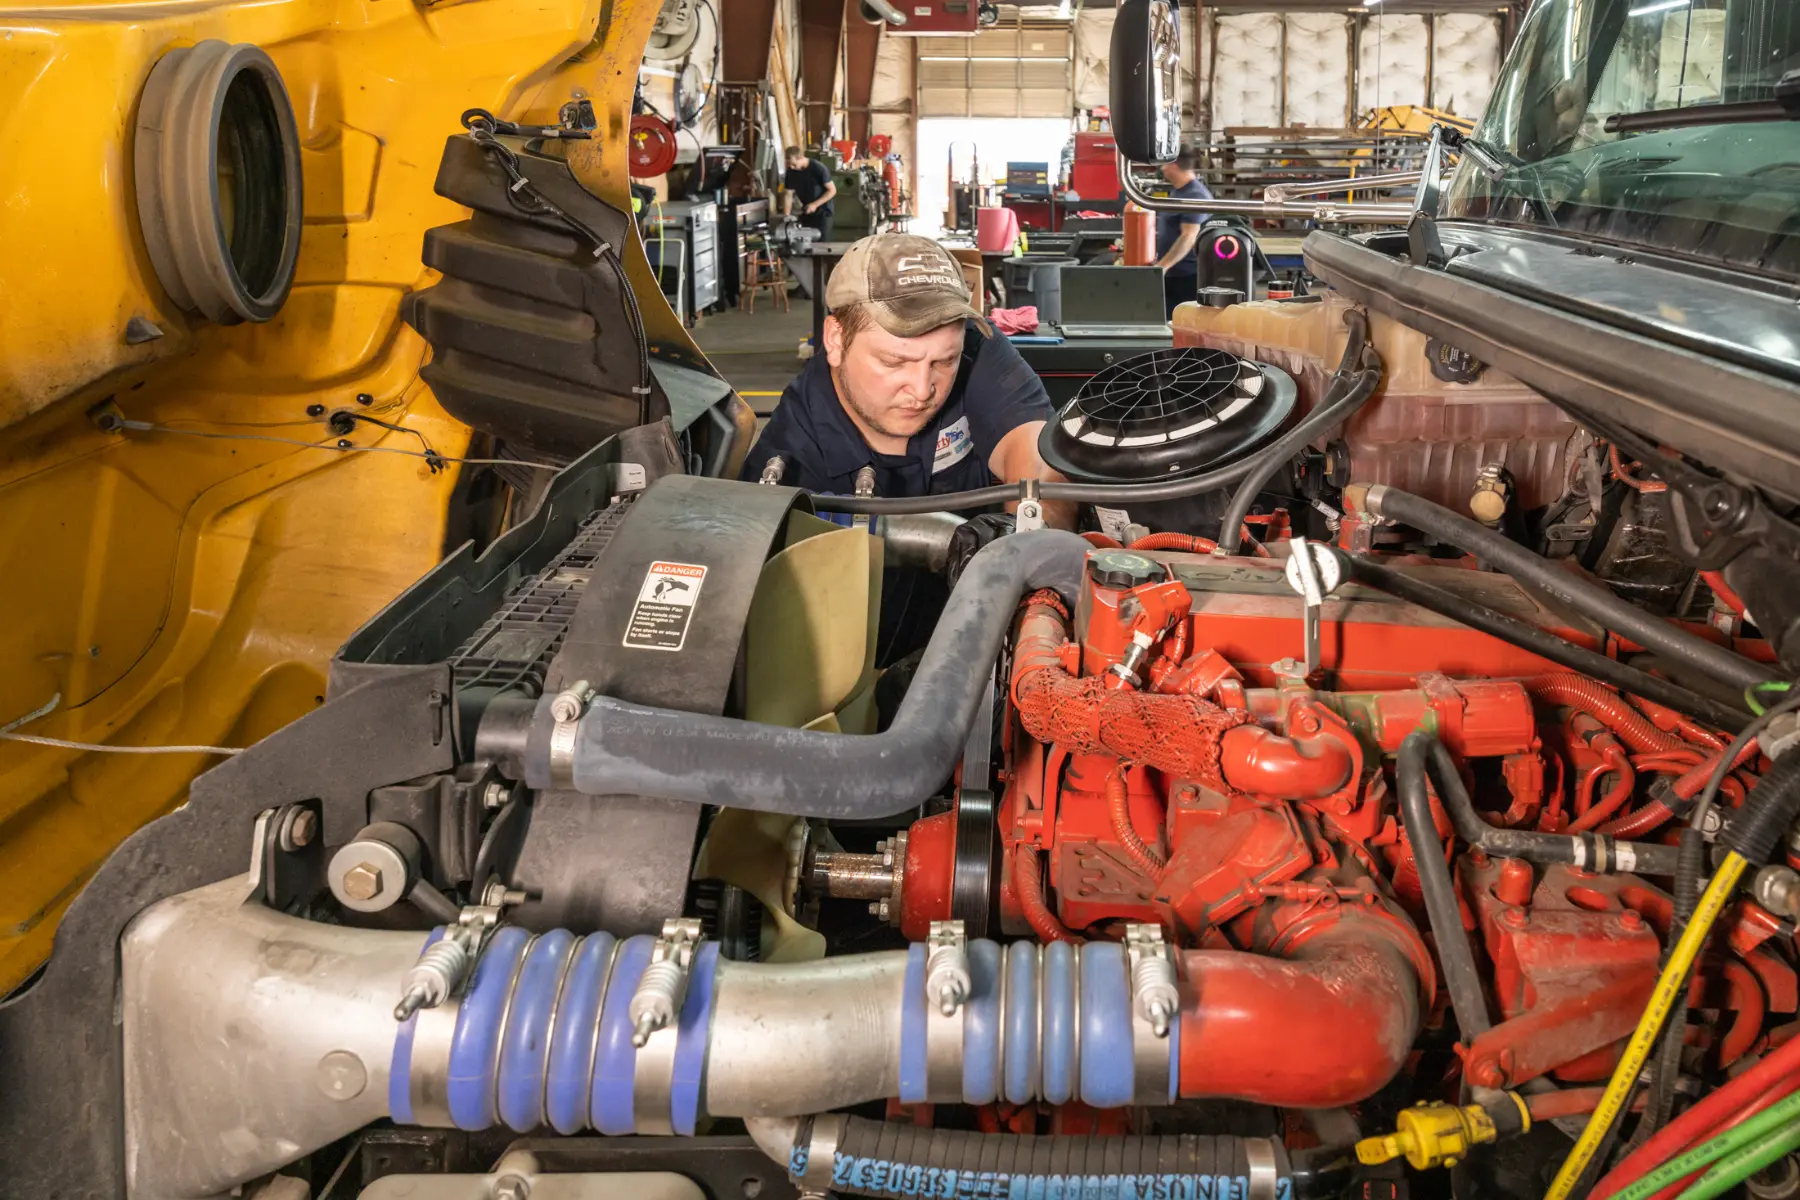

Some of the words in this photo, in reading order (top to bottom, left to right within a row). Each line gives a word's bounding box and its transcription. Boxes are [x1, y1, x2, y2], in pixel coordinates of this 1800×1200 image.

[663, 566, 702, 575] DANGER
[860, 1163, 949, 1193] SERIES
[1134, 1178, 1186, 1200] USA
